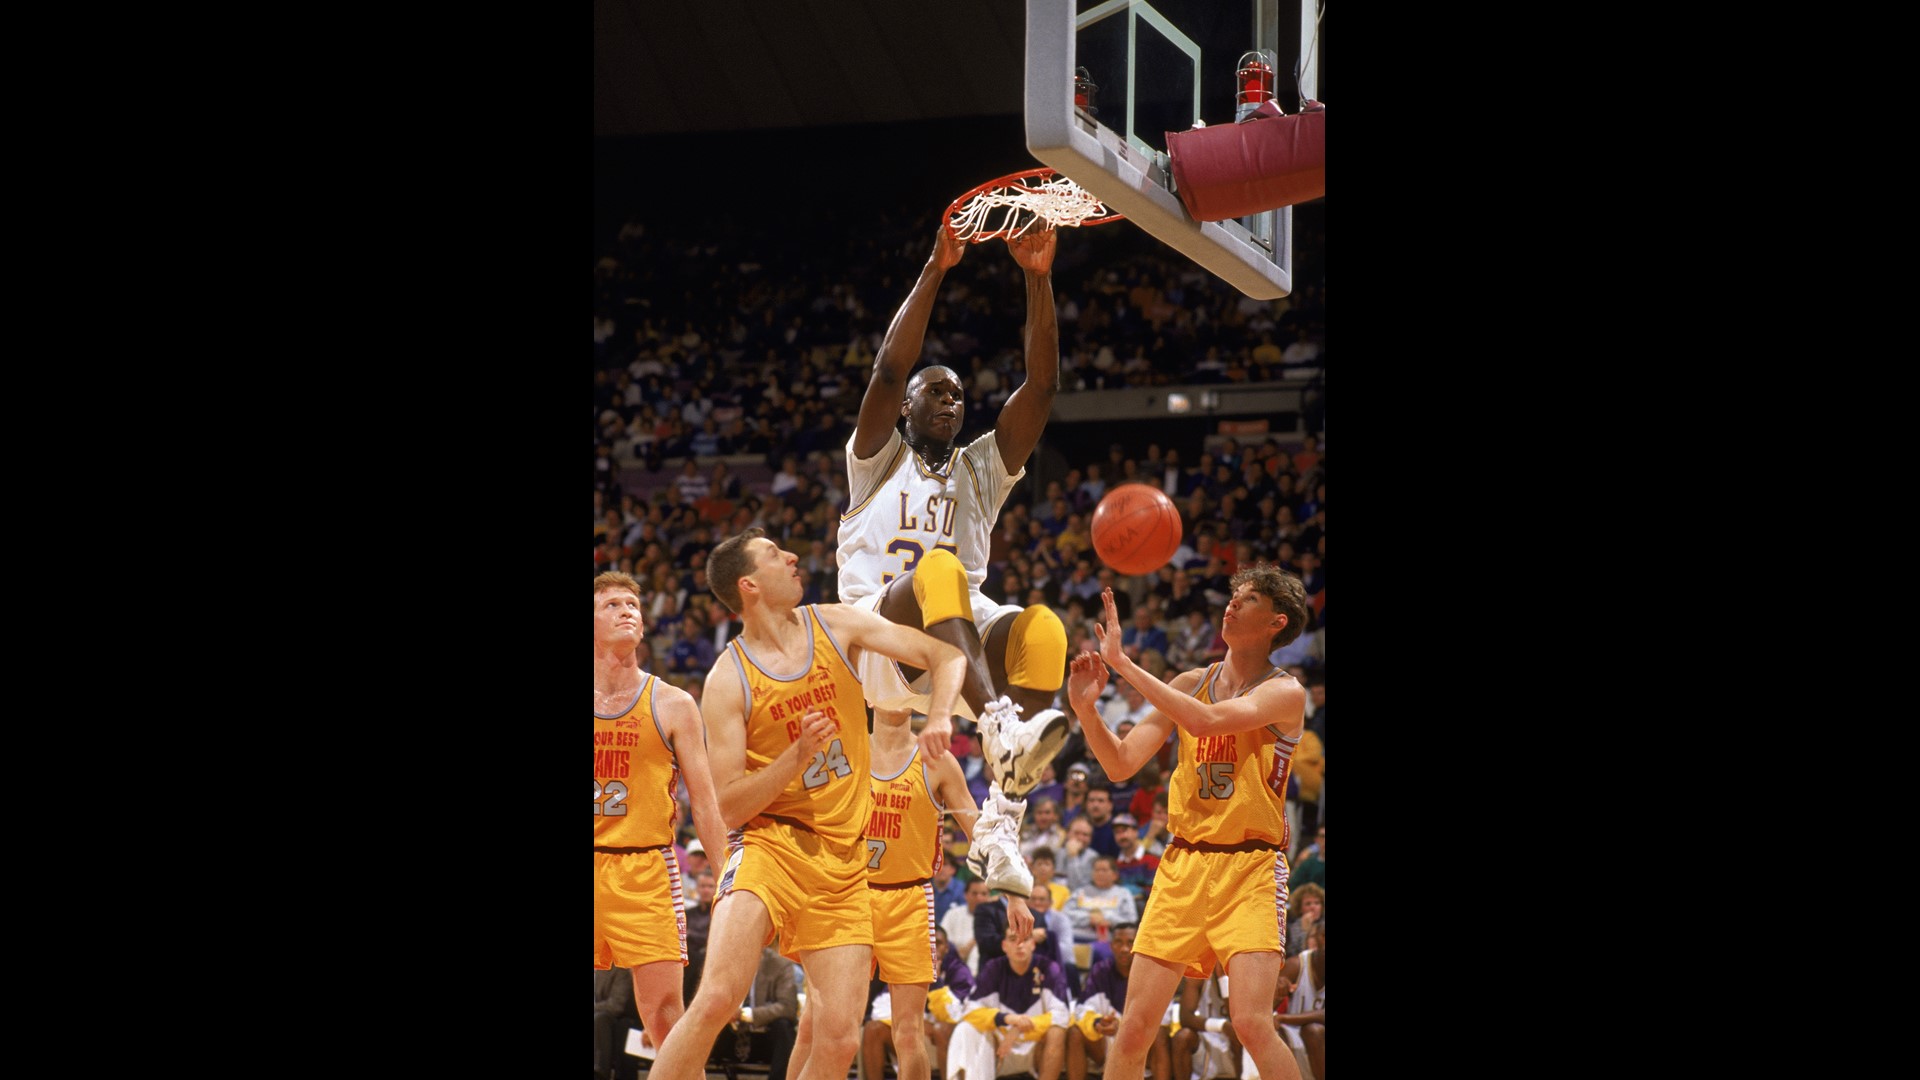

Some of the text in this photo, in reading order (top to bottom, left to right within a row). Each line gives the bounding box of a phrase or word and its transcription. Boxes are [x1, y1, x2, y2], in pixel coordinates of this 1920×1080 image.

[900, 490, 957, 538] LSU
[881, 536, 958, 586] 3
[769, 703, 786, 721] BE
[785, 691, 814, 715] YOUR
[813, 683, 837, 704] BEST
[594, 731, 639, 747] OUR BEST
[594, 749, 630, 779] ANTS
[802, 738, 853, 790] 24
[1197, 762, 1235, 800] 15
[876, 792, 912, 811] UR BEST
[866, 810, 902, 840] ANTS
